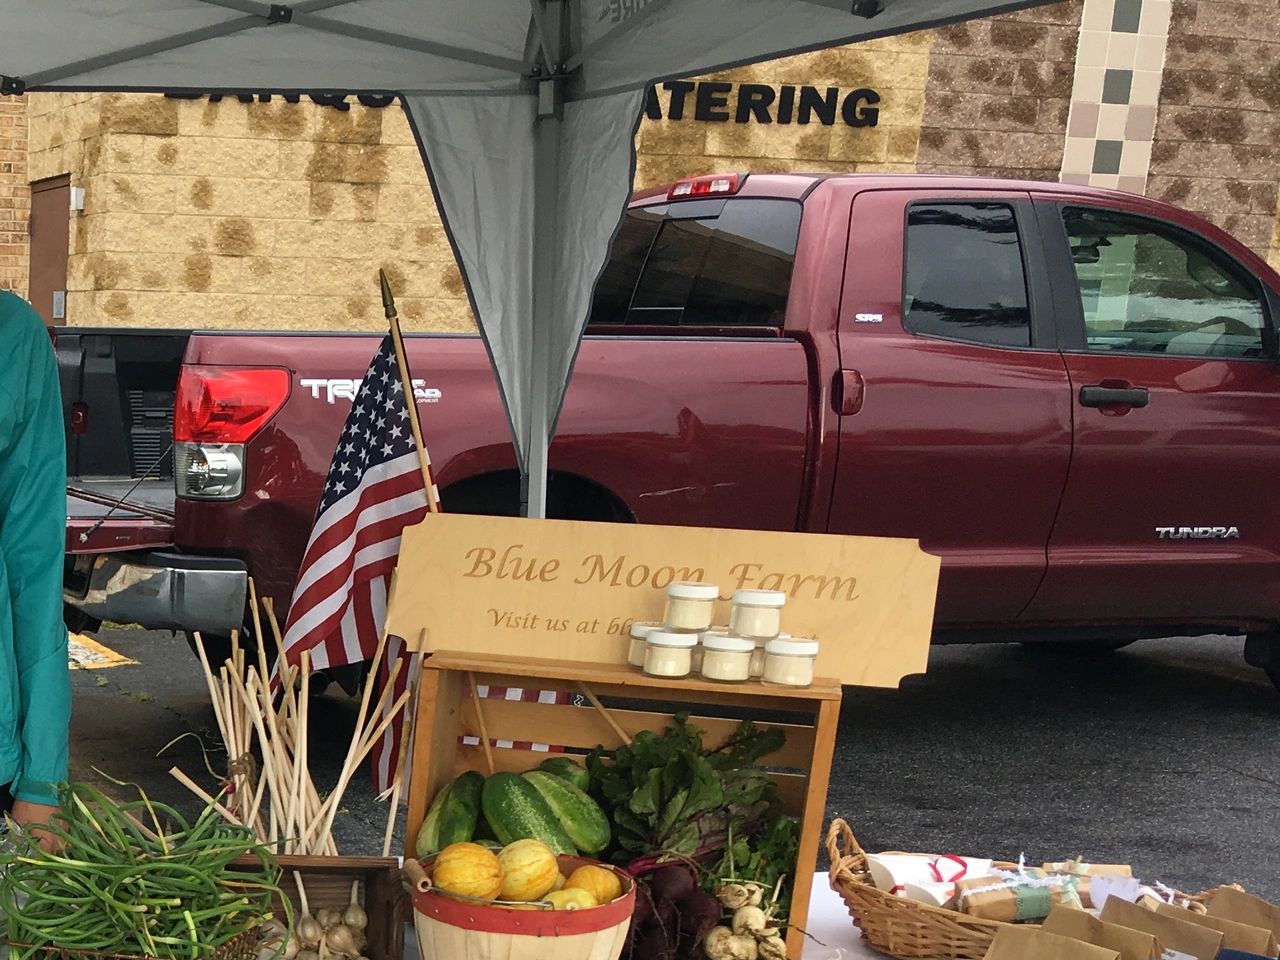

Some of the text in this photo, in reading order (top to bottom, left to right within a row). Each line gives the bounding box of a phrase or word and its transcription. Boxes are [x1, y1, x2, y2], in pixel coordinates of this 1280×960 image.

[300, 379, 363, 404] TR
[1155, 526, 1240, 539] TUNDRA
[463, 544, 560, 583] Blue
[574, 553, 705, 590] Moon
[487, 607, 539, 630] Visit
[545, 617, 570, 632] us
[575, 618, 600, 634] at
